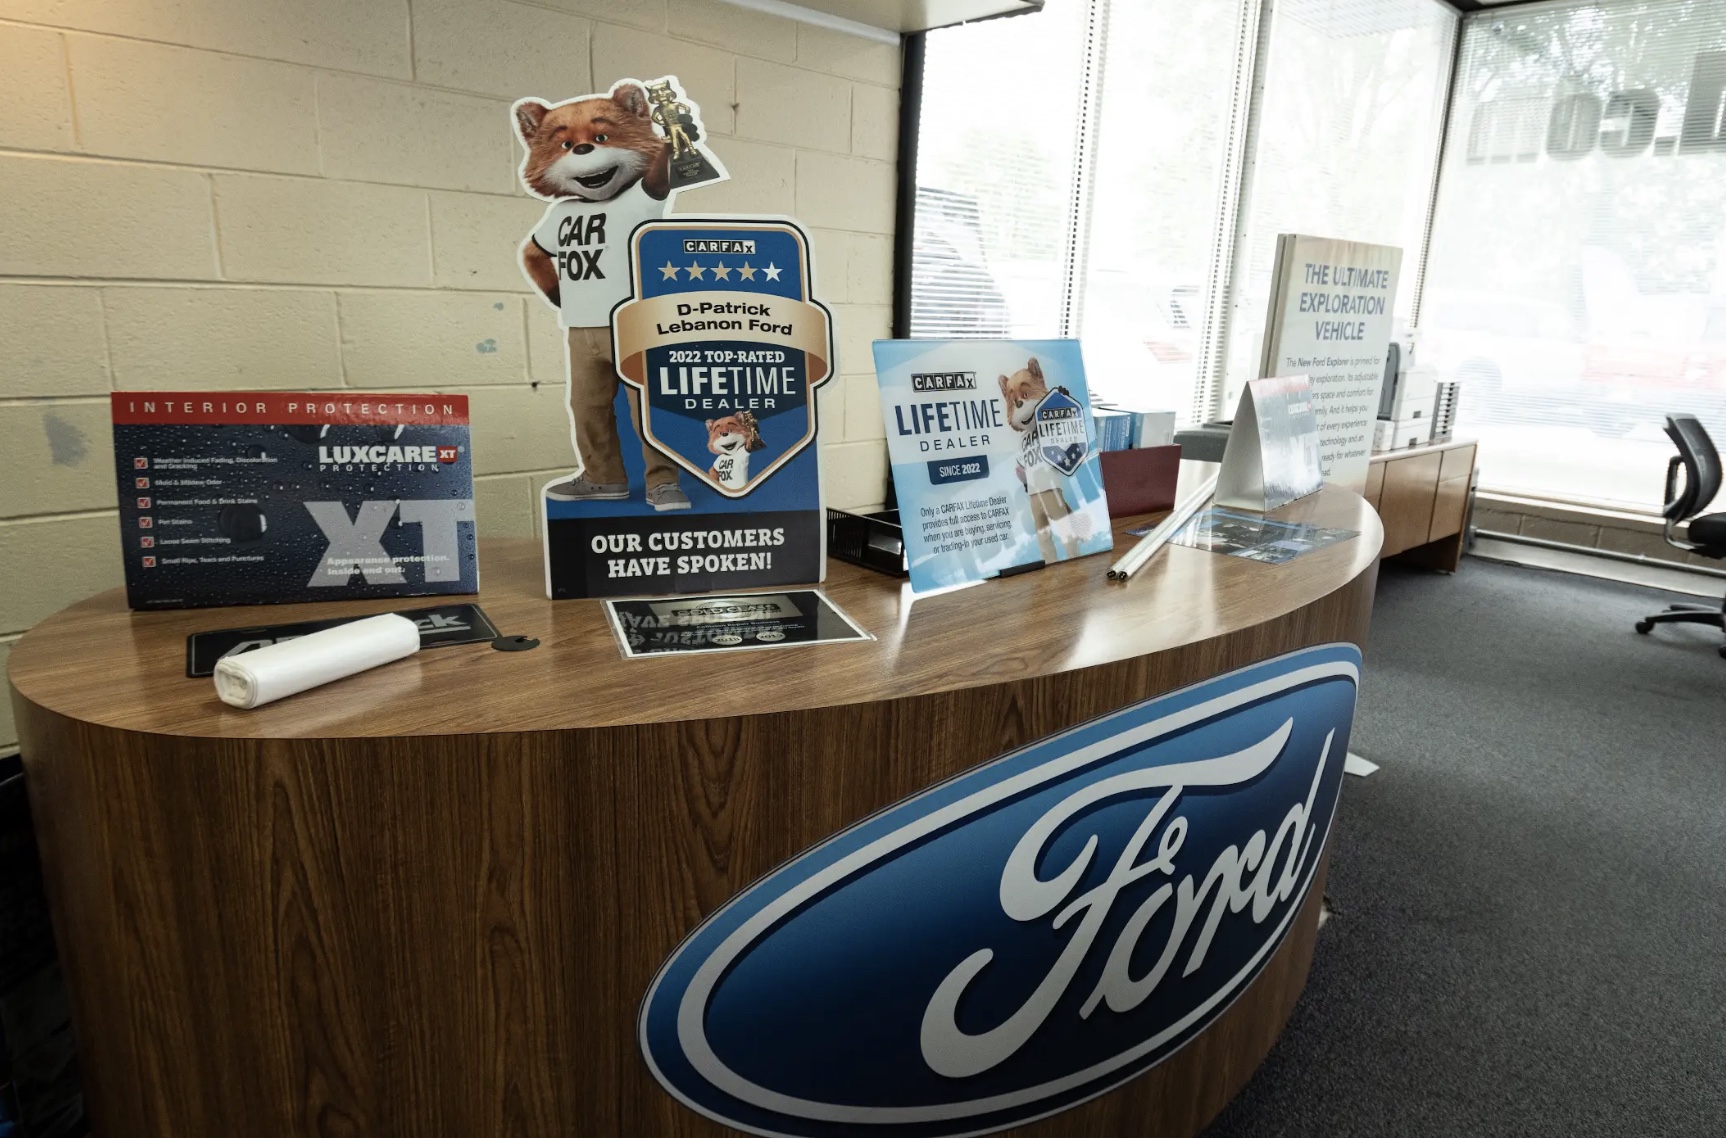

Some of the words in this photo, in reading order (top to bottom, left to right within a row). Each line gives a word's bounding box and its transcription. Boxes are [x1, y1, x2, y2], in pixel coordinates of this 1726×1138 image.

[557, 212, 606, 247] CAR
[684, 240, 755, 253] CARFAX
[558, 249, 606, 281] FOX
[1304, 263, 1330, 285] THE
[1333, 266, 1389, 290] ULTIMATE
[676, 302, 771, 317] D-Patrick
[1299, 293, 1385, 315] EXPLORATION
[656, 319, 743, 336] Lebanon
[749, 319, 793, 336] Ford
[1315, 321, 1365, 341] VEHICLE
[669, 351, 701, 363] 2022
[705, 351, 785, 363] TOP-RATED
[1286, 357, 1297, 367] The
[1298, 357, 1311, 367] New
[1312, 356, 1326, 367] Ford
[1327, 356, 1350, 368] Explorer
[659, 366, 796, 396] LIFETIME
[912, 372, 976, 391] CARFAX
[1316, 373, 1345, 386] exploration.
[1320, 391, 1335, 402] space
[1336, 390, 1346, 398] and
[129, 402, 267, 415] INTERIOR
[288, 403, 454, 415] PROTECTION
[685, 398, 776, 410] DEALER
[1329, 405, 1340, 414] And
[895, 398, 1003, 436] LIFETIME
[1042, 408, 1077, 420] CARFAX
[1039, 420, 1085, 437] LIFETIME
[1326, 422, 1340, 432] every
[1341, 419, 1367, 430] experience
[920, 435, 991, 452] DEALER
[1051, 436, 1078, 444] DEALER
[1348, 434, 1358, 443] and
[318, 445, 437, 463] LUXCARE
[440, 450, 456, 458] XT
[1322, 452, 1335, 462] ready
[319, 464, 439, 472] PROTECTION
[719, 459, 733, 469] CAR
[939, 464, 961, 478] SINCE
[962, 463, 981, 475] 2022
[718, 470, 733, 481] FOX
[920, 507, 935, 518] Only
[940, 501, 964, 514] CARFAX
[988, 496, 1007, 507] Dealer
[922, 518, 948, 532] provides
[949, 515, 959, 525] full
[960, 514, 980, 523] access
[980, 511, 987, 519] to
[987, 506, 1009, 519] CARFAX
[590, 534, 642, 553] OUR
[648, 528, 785, 551] CUSTOMERS
[924, 532, 941, 543] when
[942, 530, 953, 541] you
[954, 528, 964, 537] are
[933, 546, 940, 554] or
[941, 540, 970, 553] trading-in
[971, 536, 983, 548] your
[984, 532, 998, 543] used
[303, 500, 475, 587] XT
[327, 557, 391, 566] Appearance
[392, 554, 450, 564] protection.
[608, 557, 671, 579] HAVE
[677, 552, 772, 575] SPOKEN!
[328, 567, 361, 575] Inside
[920, 716, 1335, 1078] Ford
